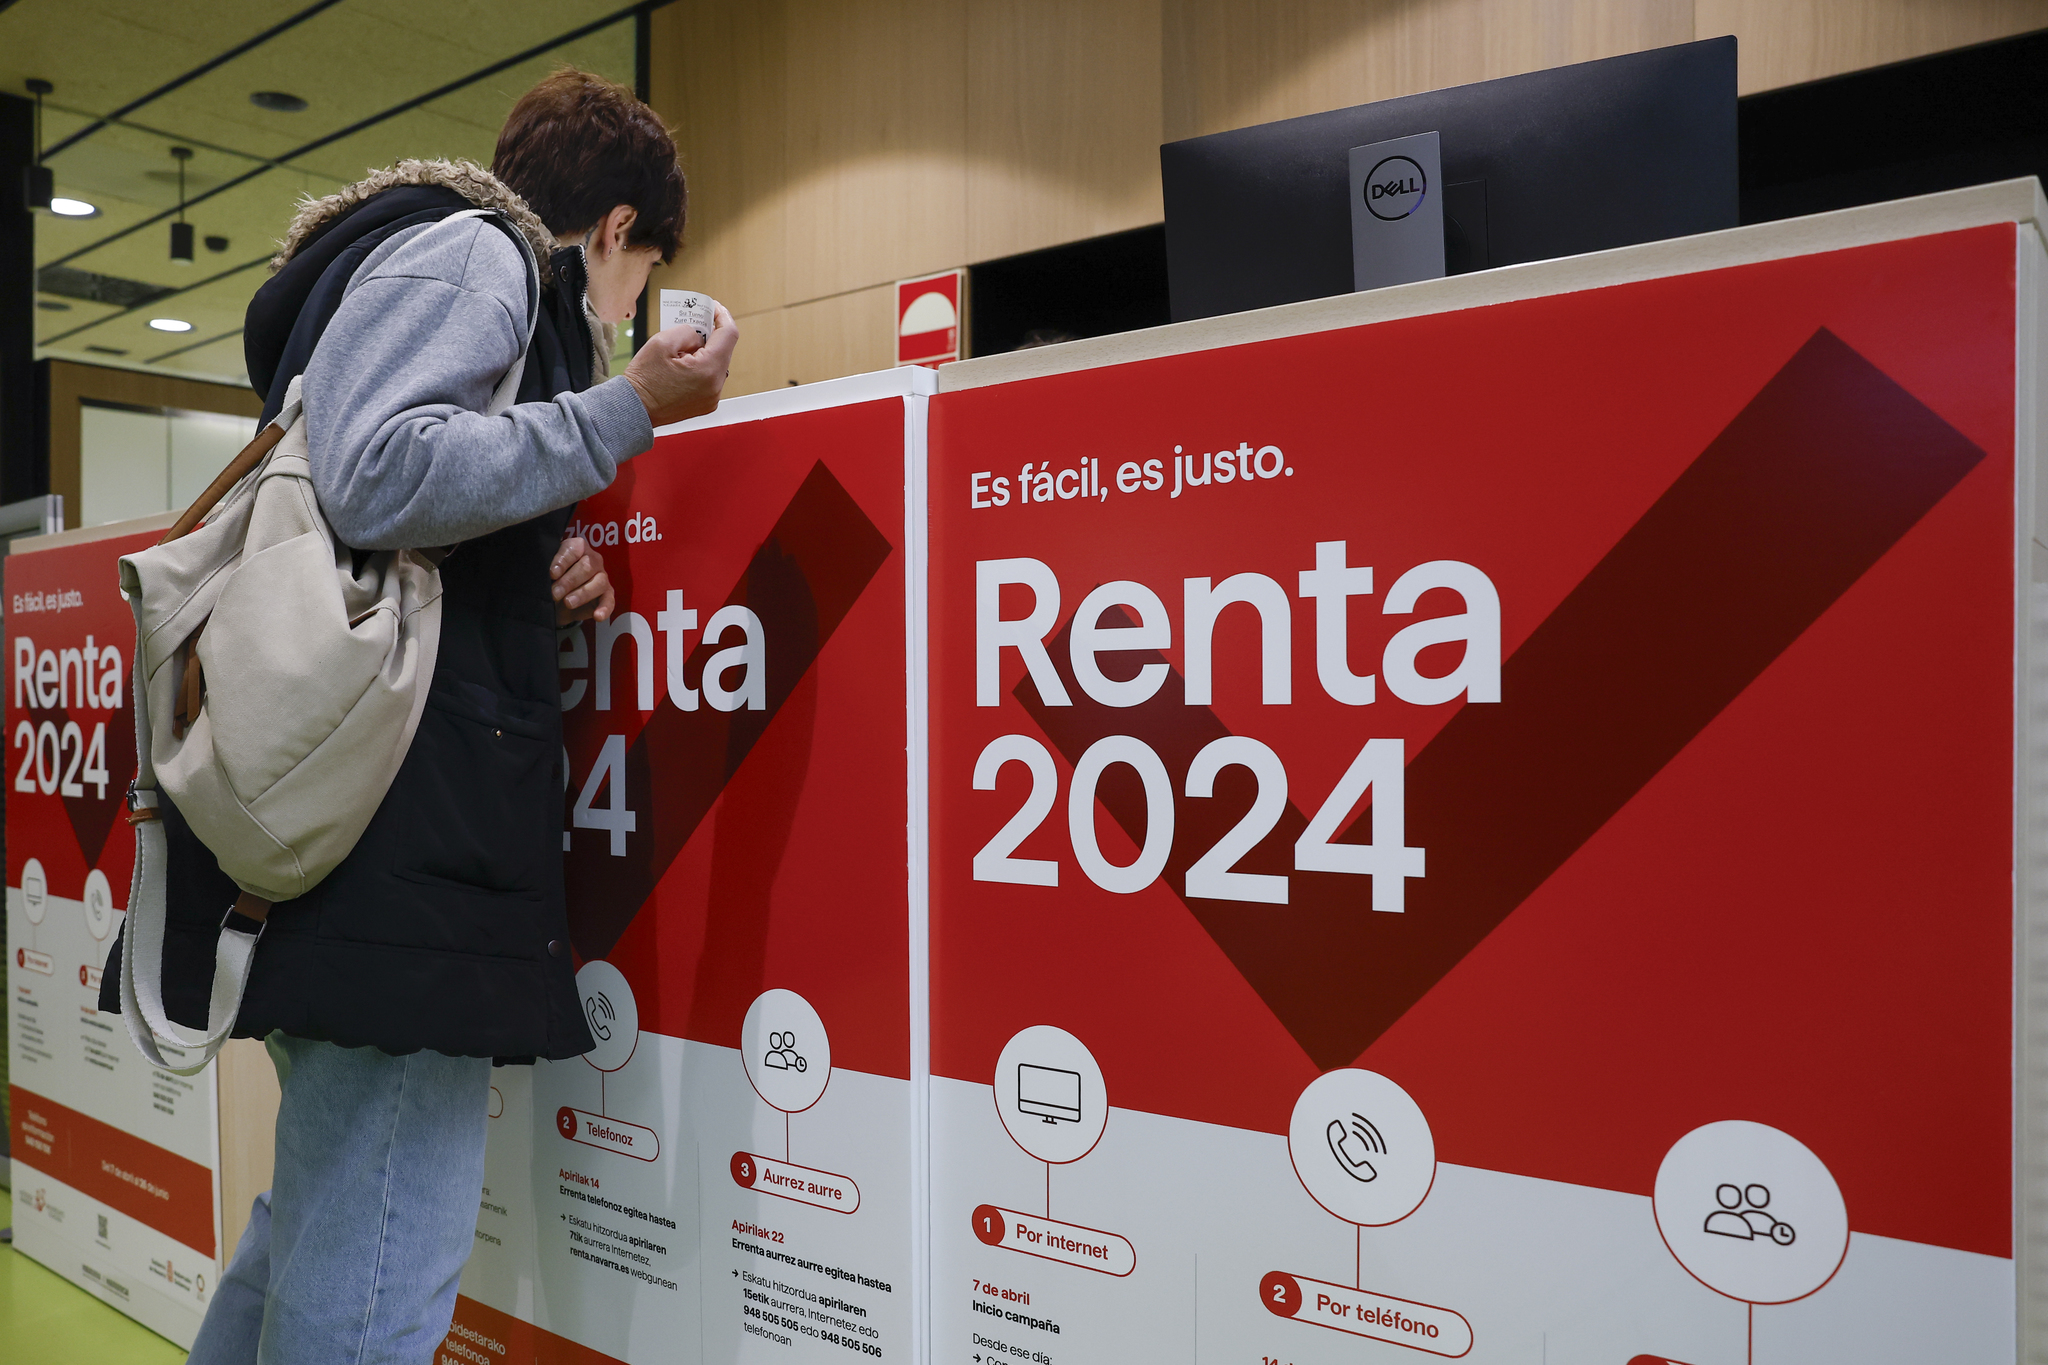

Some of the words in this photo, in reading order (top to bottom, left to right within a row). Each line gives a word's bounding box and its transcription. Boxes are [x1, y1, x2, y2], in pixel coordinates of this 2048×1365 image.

[1372, 178, 1420, 200] DELL
[971, 471, 1011, 509] Es
[1018, 456, 1108, 503] fácil,
[1116, 458, 1164, 493] es
[1170, 442, 1294, 499] justo.
[624, 511, 662, 544] da.
[975, 540, 1501, 708] Renta
[14, 635, 123, 709] Renta
[14, 720, 109, 800] 2024
[972, 733, 1426, 913] 2024
[562, 1115, 570, 1129] 2
[586, 1121, 633, 1146] Telefonoz
[559, 1168, 590, 1187] Apirilak
[590, 1178, 600, 1189] 14
[740, 1162, 750, 1177] 3
[763, 1168, 805, 1191] Aurrez
[807, 1182, 842, 1200] aurre
[560, 1185, 587, 1202] Errenta
[587, 1194, 623, 1213] telefonoz
[623, 1206, 648, 1221] egitea
[648, 1212, 676, 1229] hastea
[568, 1214, 592, 1231] Eskatu
[593, 1222, 628, 1243] hitzordua
[628, 1235, 667, 1255] apirilaren
[570, 1230, 583, 1243] 7tik
[584, 1235, 611, 1252] aurrera
[731, 1219, 770, 1240] Apirilak
[771, 1231, 785, 1244] 22
[983, 1216, 991, 1233] 1
[1016, 1223, 1042, 1244] Por
[1046, 1231, 1109, 1260] internet
[570, 1246, 630, 1274] renta.navarra.es
[630, 1267, 678, 1291] webgunean
[732, 1238, 765, 1257] Errenta
[766, 1248, 796, 1266] aurrez
[797, 1258, 824, 1273] aurre
[824, 1266, 856, 1283] egitea
[857, 1273, 892, 1293] hastea
[742, 1271, 771, 1288] Eskatu
[772, 1279, 817, 1303] hitzordua
[818, 1295, 867, 1317] apirilaren
[972, 1279, 980, 1291] 7
[982, 1283, 999, 1297] de
[1001, 1289, 1030, 1305] abril
[1273, 1284, 1286, 1304] 2
[1317, 1293, 1350, 1317] Por
[1356, 1303, 1439, 1338] teléfono
[743, 1288, 770, 1305] 15etik
[770, 1297, 807, 1319] aurrera,
[808, 1308, 857, 1333] Internetez
[858, 1325, 879, 1339] edo
[743, 1305, 761, 1319] 948
[762, 1311, 780, 1325] 505
[781, 1317, 799, 1332] 505
[800, 1325, 819, 1338] edo
[820, 1330, 840, 1344] 948
[841, 1336, 861, 1351] 505
[862, 1343, 882, 1358] 506
[743, 1322, 792, 1346] telefonoan
[972, 1299, 1003, 1318] Inicio
[1005, 1309, 1060, 1334] campaña
[445, 1337, 490, 1365] telefonoa
[972, 1333, 1008, 1353] Desde
[1009, 1344, 1030, 1359] ese
[1032, 1350, 1053, 1365] día:
